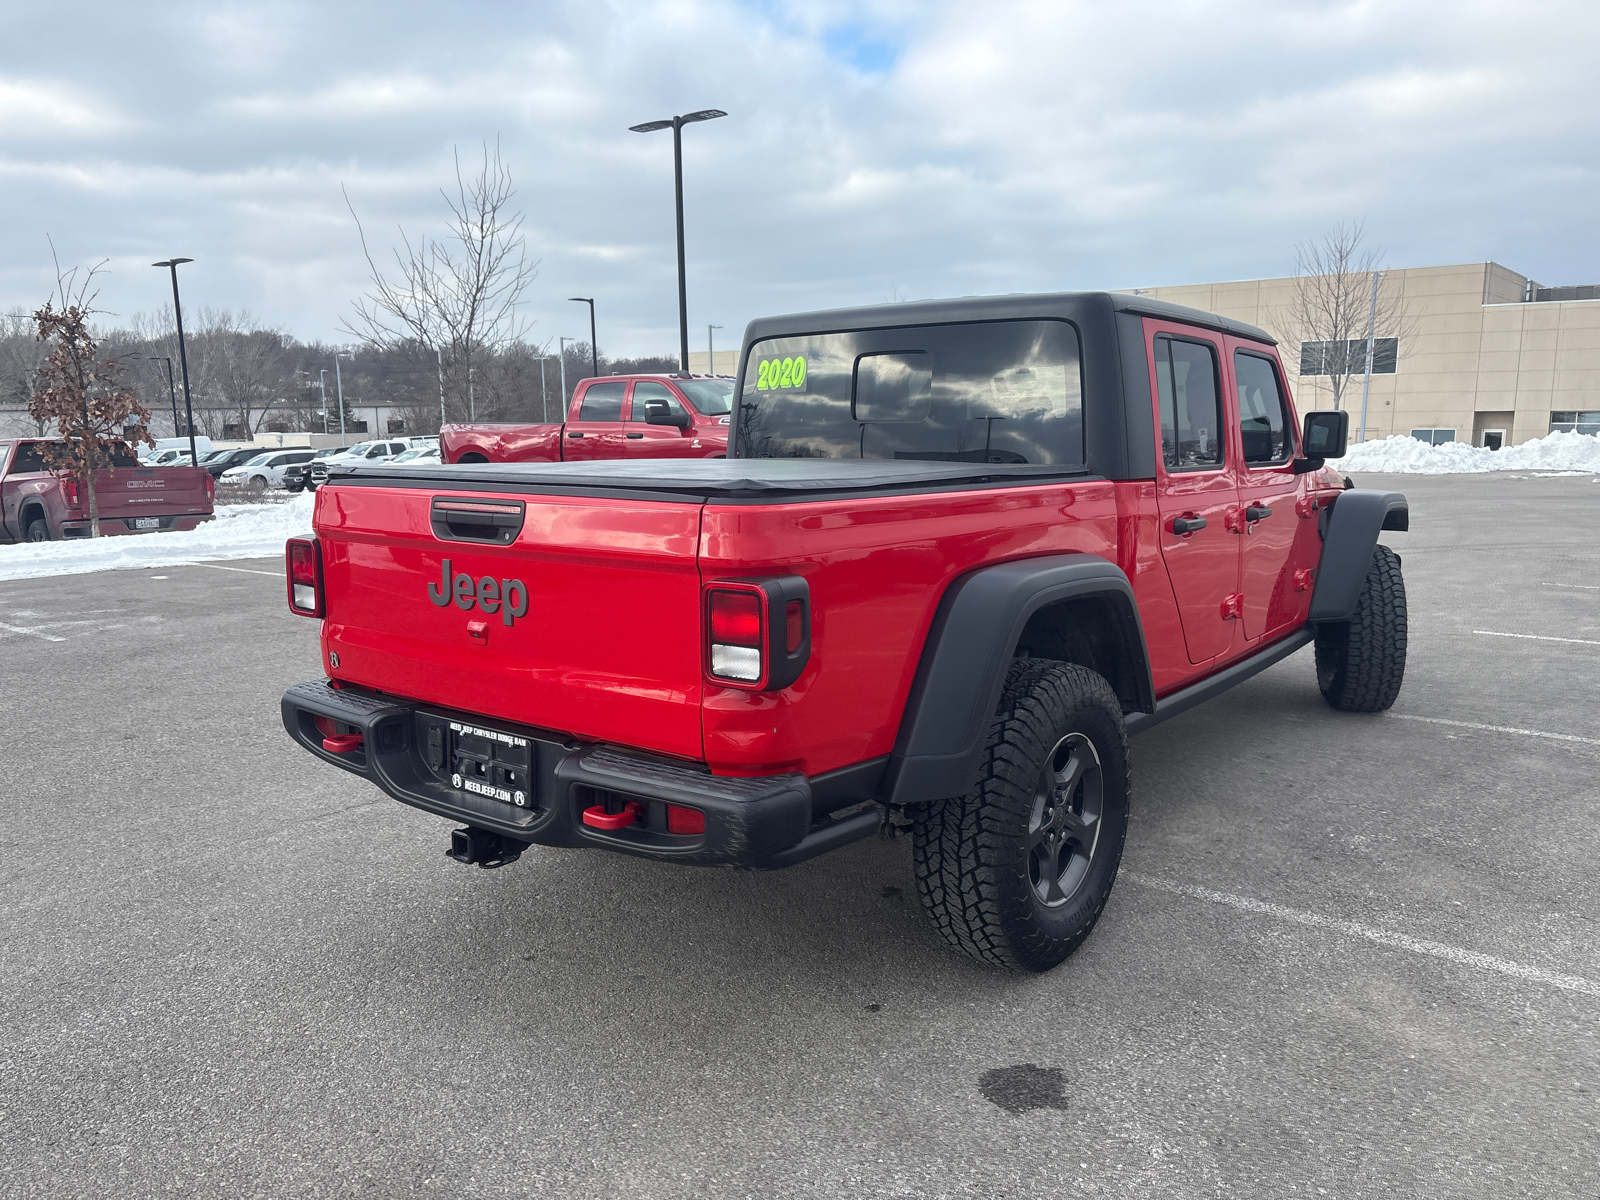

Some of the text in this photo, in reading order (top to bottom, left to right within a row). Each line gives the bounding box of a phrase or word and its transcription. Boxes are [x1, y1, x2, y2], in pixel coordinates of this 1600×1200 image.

[757, 356, 807, 391] 2020
[126, 480, 165, 489] GMC
[427, 558, 529, 627] Jeep
[473, 728, 498, 741] CHRYSLER
[497, 733, 514, 744] DODGE
[514, 737, 527, 747] RAM
[464, 779, 511, 802] REEDJEEP.COM
